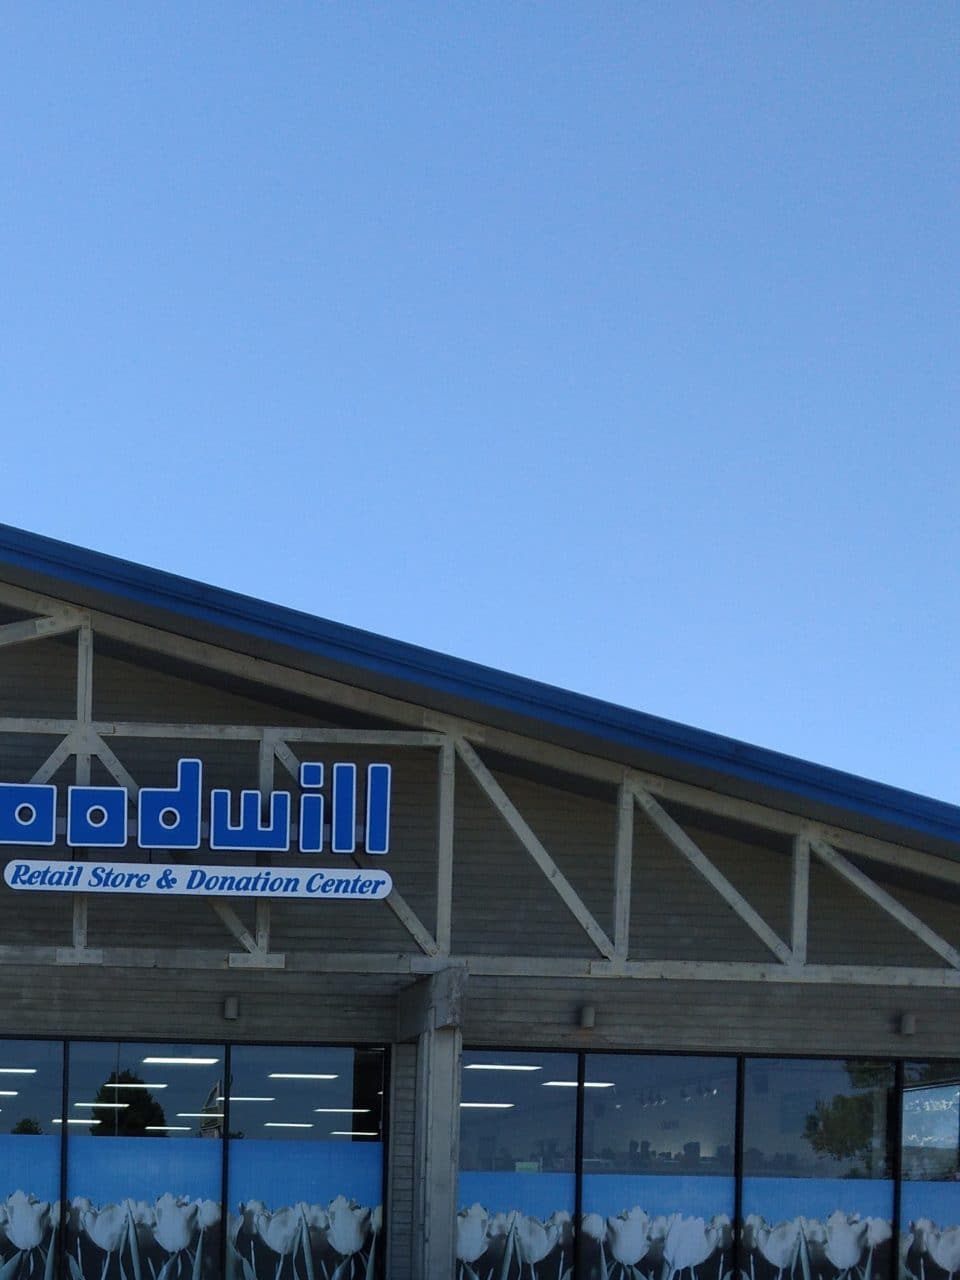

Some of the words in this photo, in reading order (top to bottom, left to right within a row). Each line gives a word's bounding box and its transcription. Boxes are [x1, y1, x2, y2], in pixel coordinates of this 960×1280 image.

[10, 864, 84, 887] Retail
[87, 866, 151, 888] Store
[155, 868, 178, 890] &
[186, 869, 300, 893] Donation
[305, 872, 386, 895] Center
